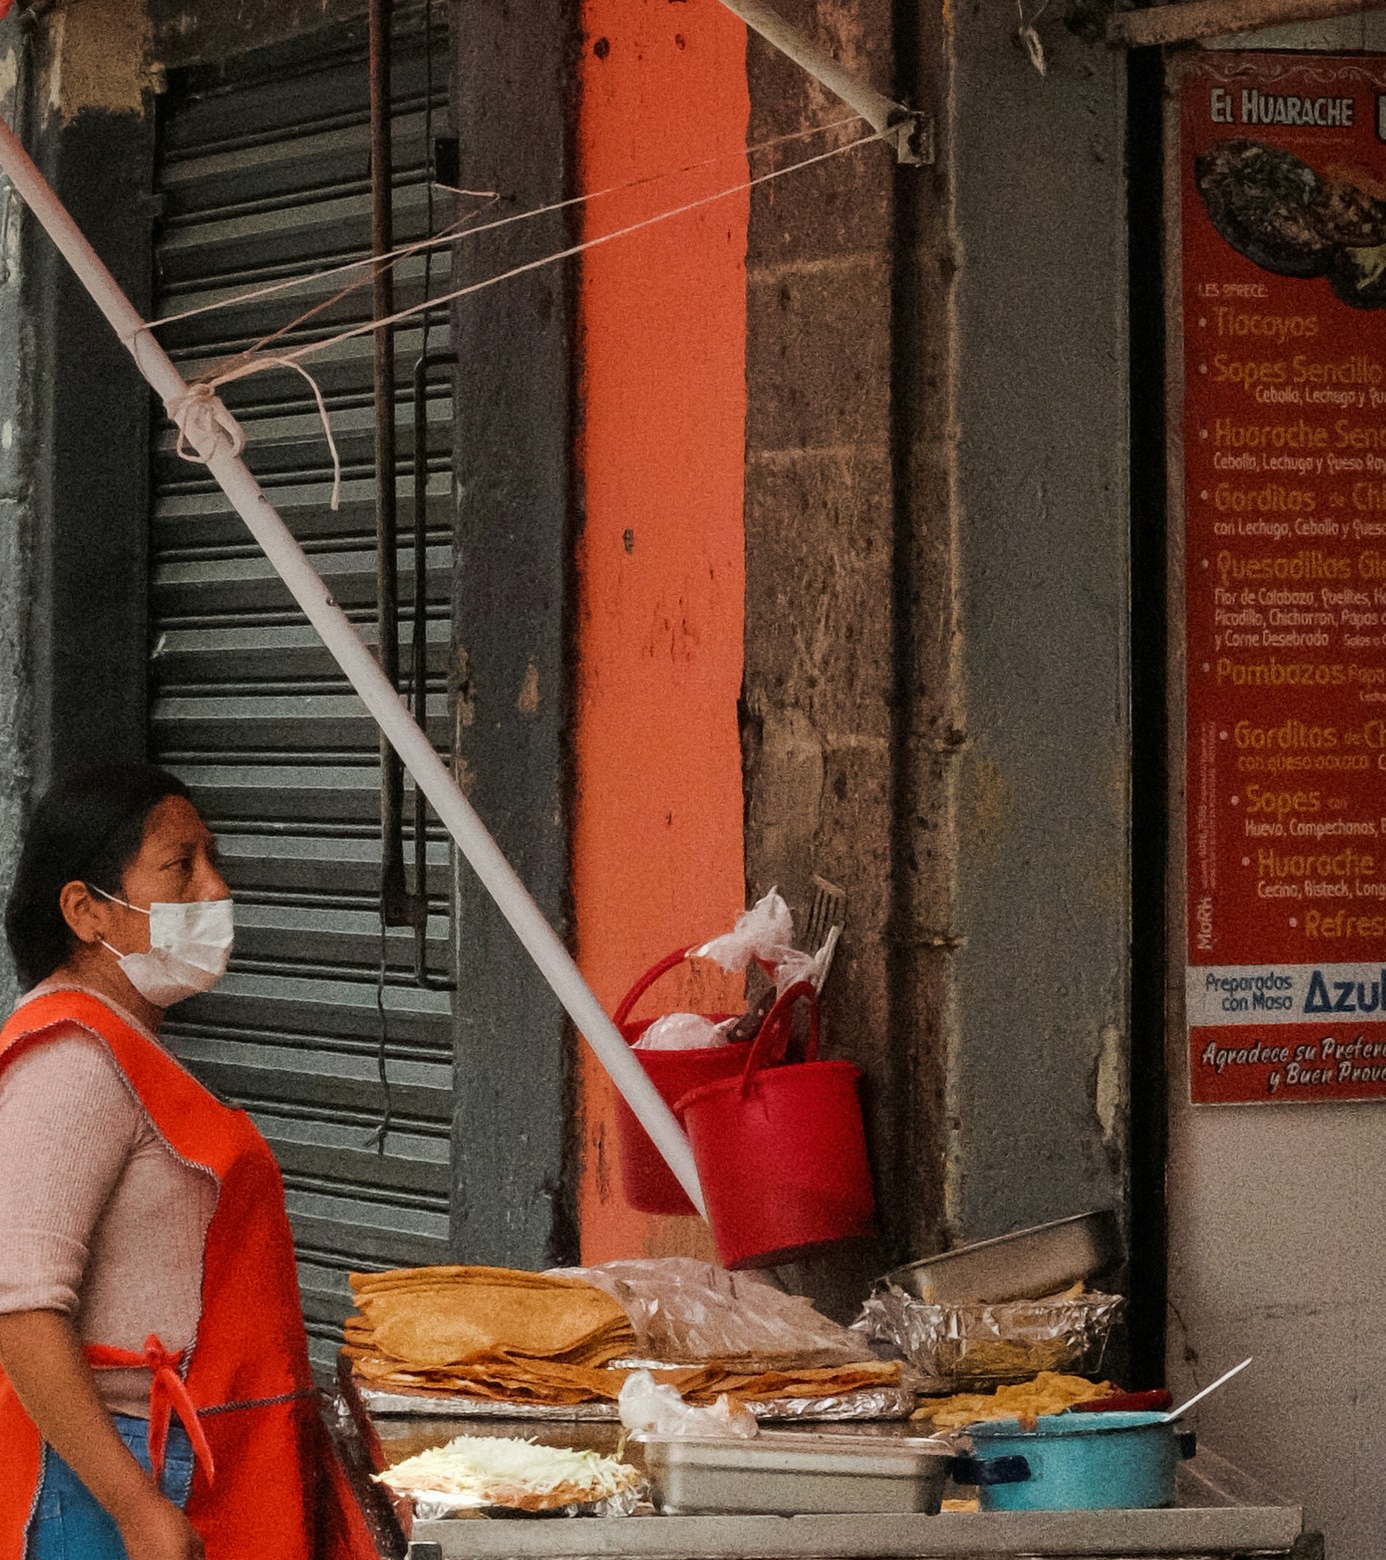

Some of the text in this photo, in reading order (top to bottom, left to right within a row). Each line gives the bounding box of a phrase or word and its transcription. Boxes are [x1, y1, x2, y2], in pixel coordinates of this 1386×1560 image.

[1213, 306, 1318, 344] Tlacoyos
[1214, 353, 1286, 390] Sopes
[1214, 419, 1328, 447] Huarache
[1316, 456, 1324, 474] y
[1214, 482, 1317, 511] Gorditas
[1217, 550, 1352, 586] Quesadillas
[1216, 657, 1346, 685] Pambazos
[1234, 719, 1338, 749] Gorditas
[1246, 784, 1322, 819] Sopes
[1258, 848, 1376, 877] Huarache
[1222, 996, 1249, 1011] con
[1201, 1039, 1289, 1074] Agradece
[1293, 1046, 1316, 1061] su
[1269, 1074, 1280, 1093] y
[1285, 1064, 1334, 1086] Buen
